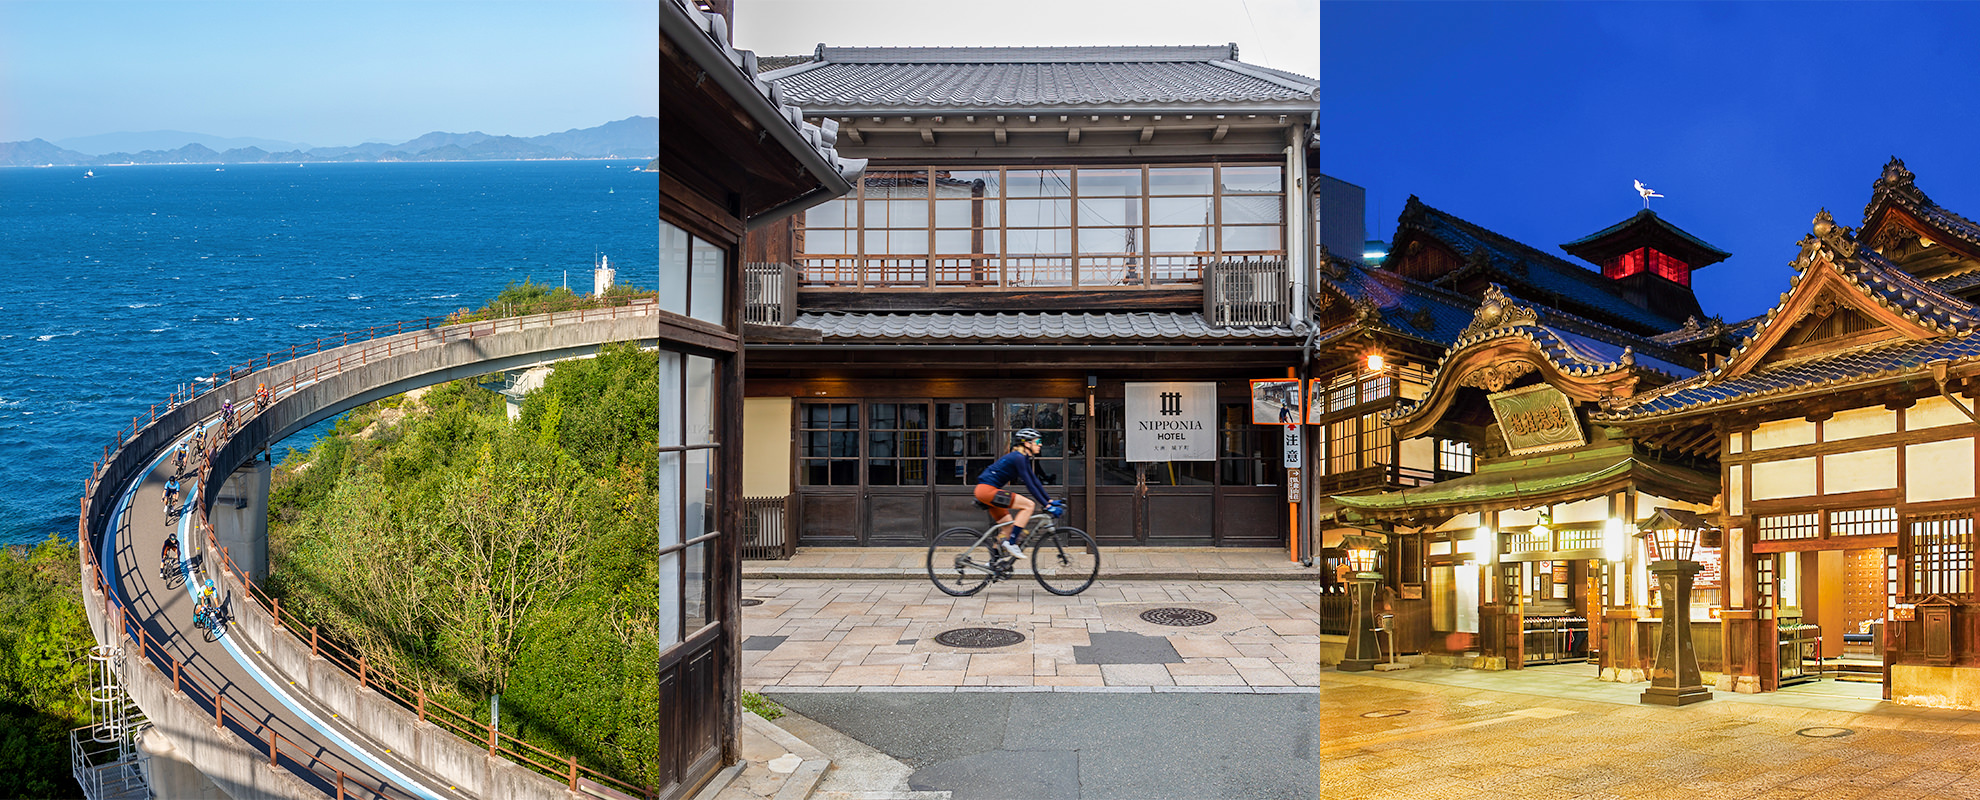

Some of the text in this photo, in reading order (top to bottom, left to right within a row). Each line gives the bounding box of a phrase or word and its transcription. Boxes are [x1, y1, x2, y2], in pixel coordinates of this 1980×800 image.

[1139, 420, 1203, 431] NIPPONIA
[1157, 432, 1186, 441] HOTEL
[1286, 434, 1298, 462] 注意
